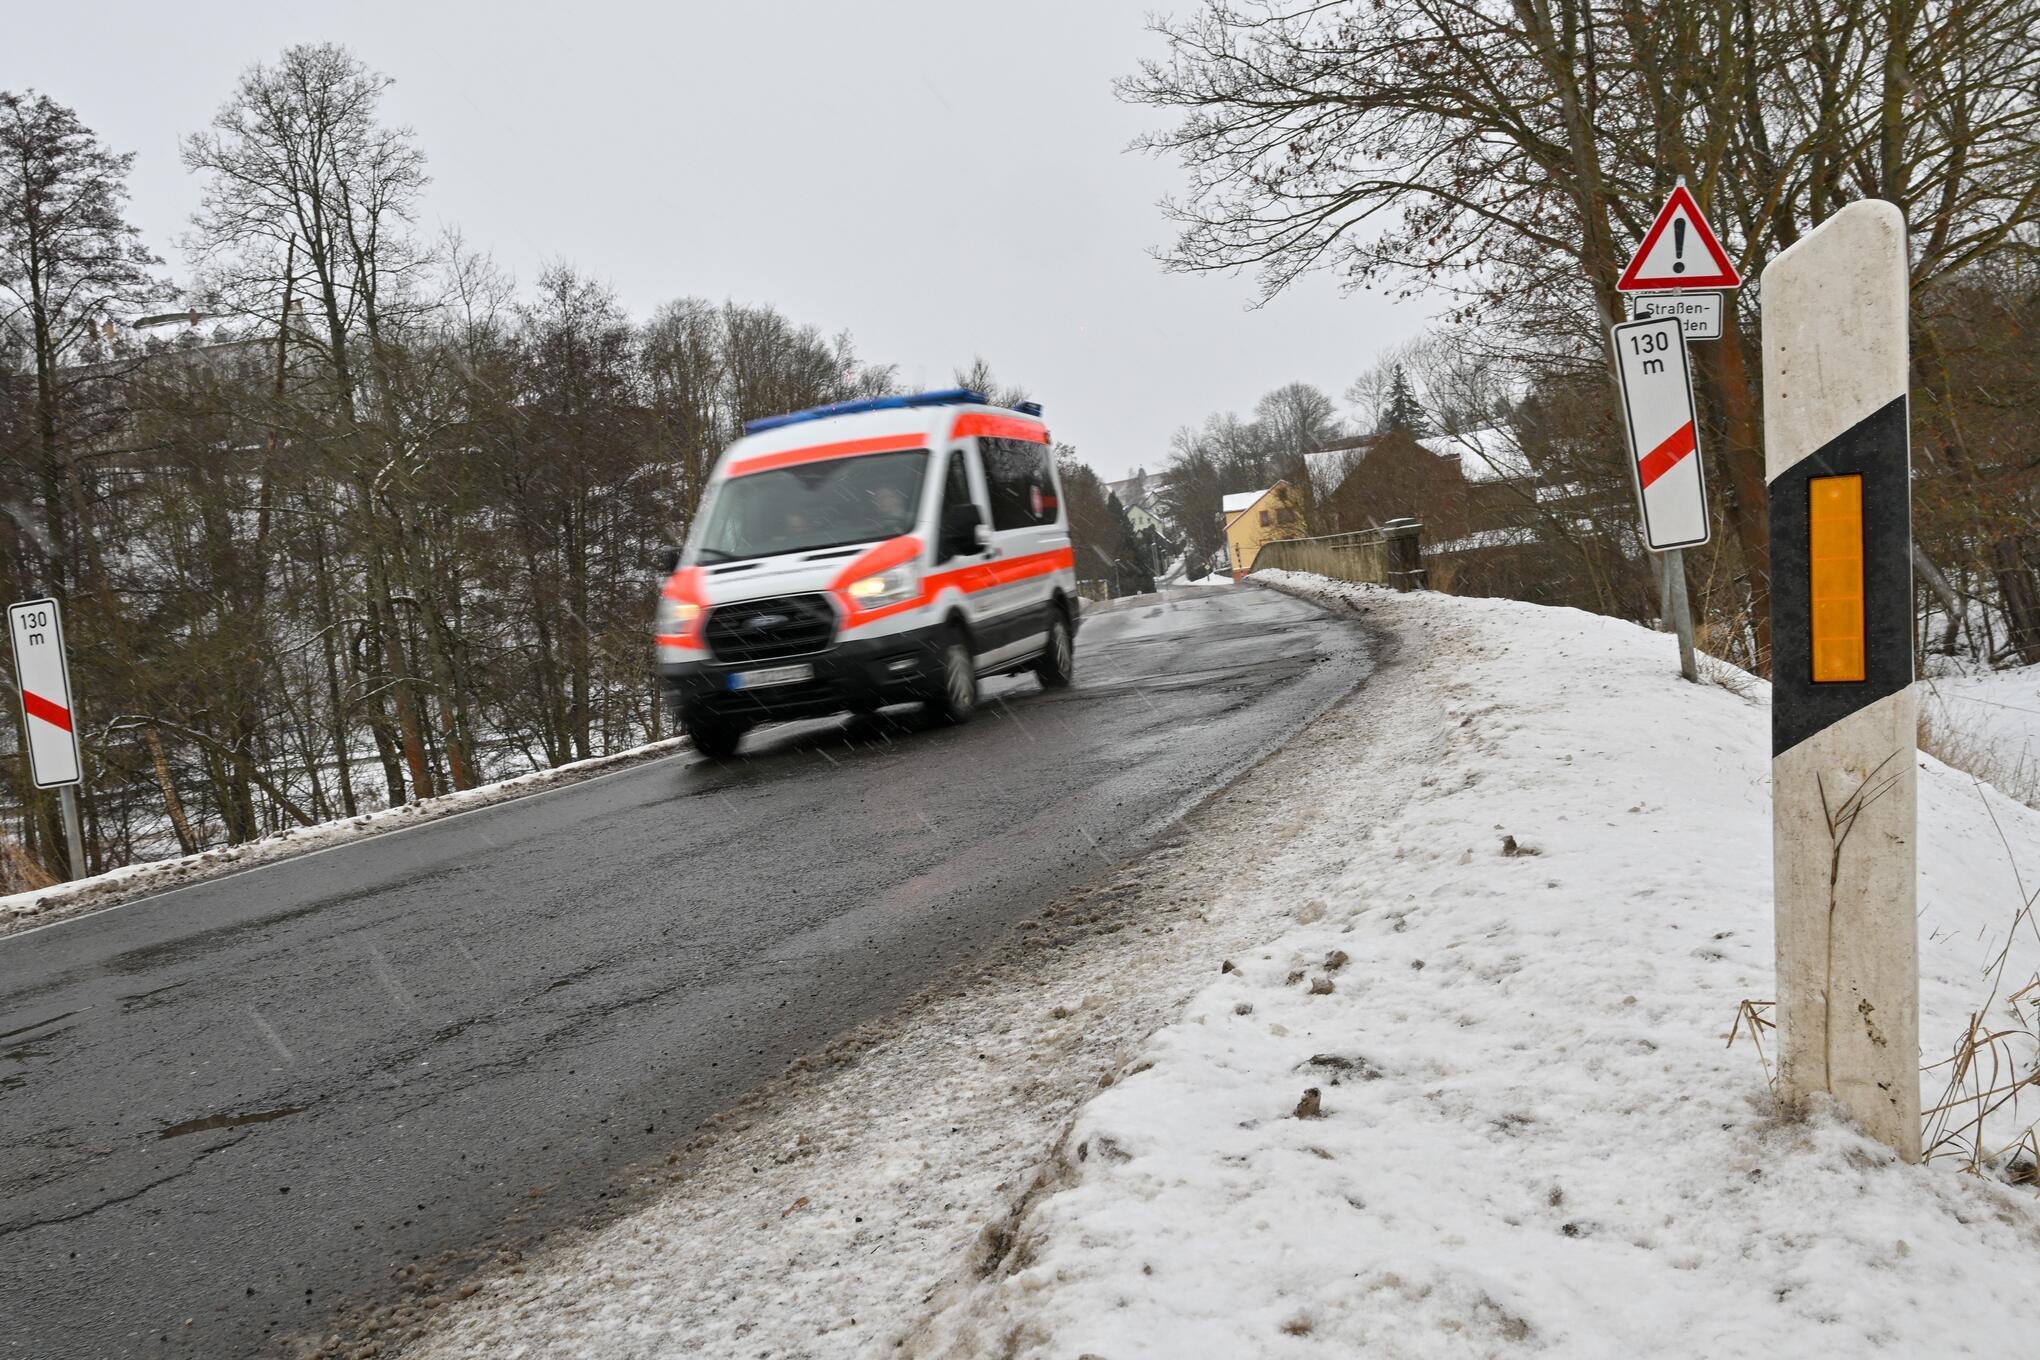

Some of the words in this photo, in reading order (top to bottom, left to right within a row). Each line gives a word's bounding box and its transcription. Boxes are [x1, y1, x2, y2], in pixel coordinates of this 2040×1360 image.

[1646, 302, 1710, 315] Straßen-
[1631, 332, 1668, 355] 130
[1643, 359, 1664, 374] m
[21, 611, 47, 630] 130
[29, 633, 44, 646] m
